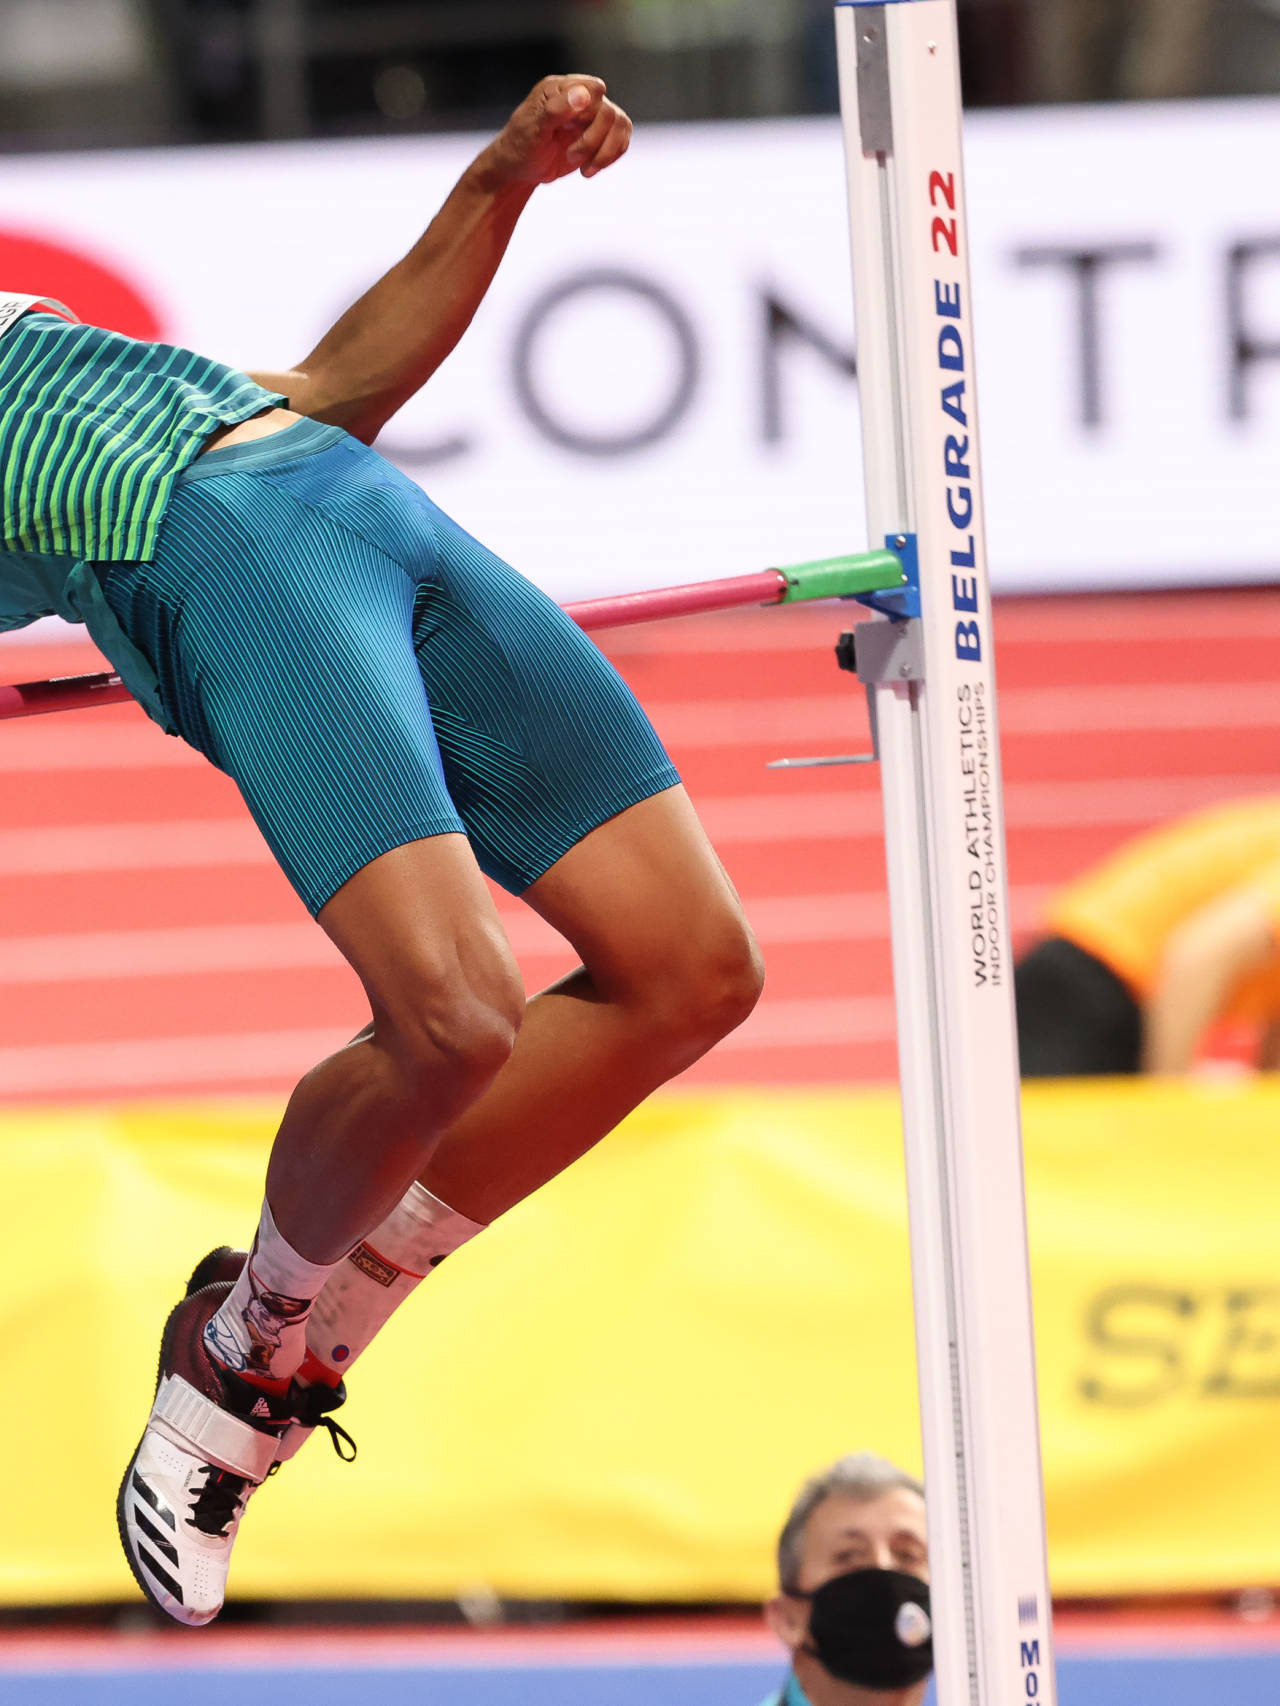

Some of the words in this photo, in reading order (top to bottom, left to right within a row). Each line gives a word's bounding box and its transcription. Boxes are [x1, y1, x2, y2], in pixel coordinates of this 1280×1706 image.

[929, 170, 958, 257] 22
[320, 238, 1280, 465] ONT
[934, 279, 982, 662] BELGRADE
[957, 684, 980, 858] ATHLETICS
[974, 681, 997, 883] CHAMPIONSHIPS
[969, 871, 987, 987] WORLD
[986, 892, 1001, 986] INDOOR
[1020, 1639, 1040, 1706] MO
